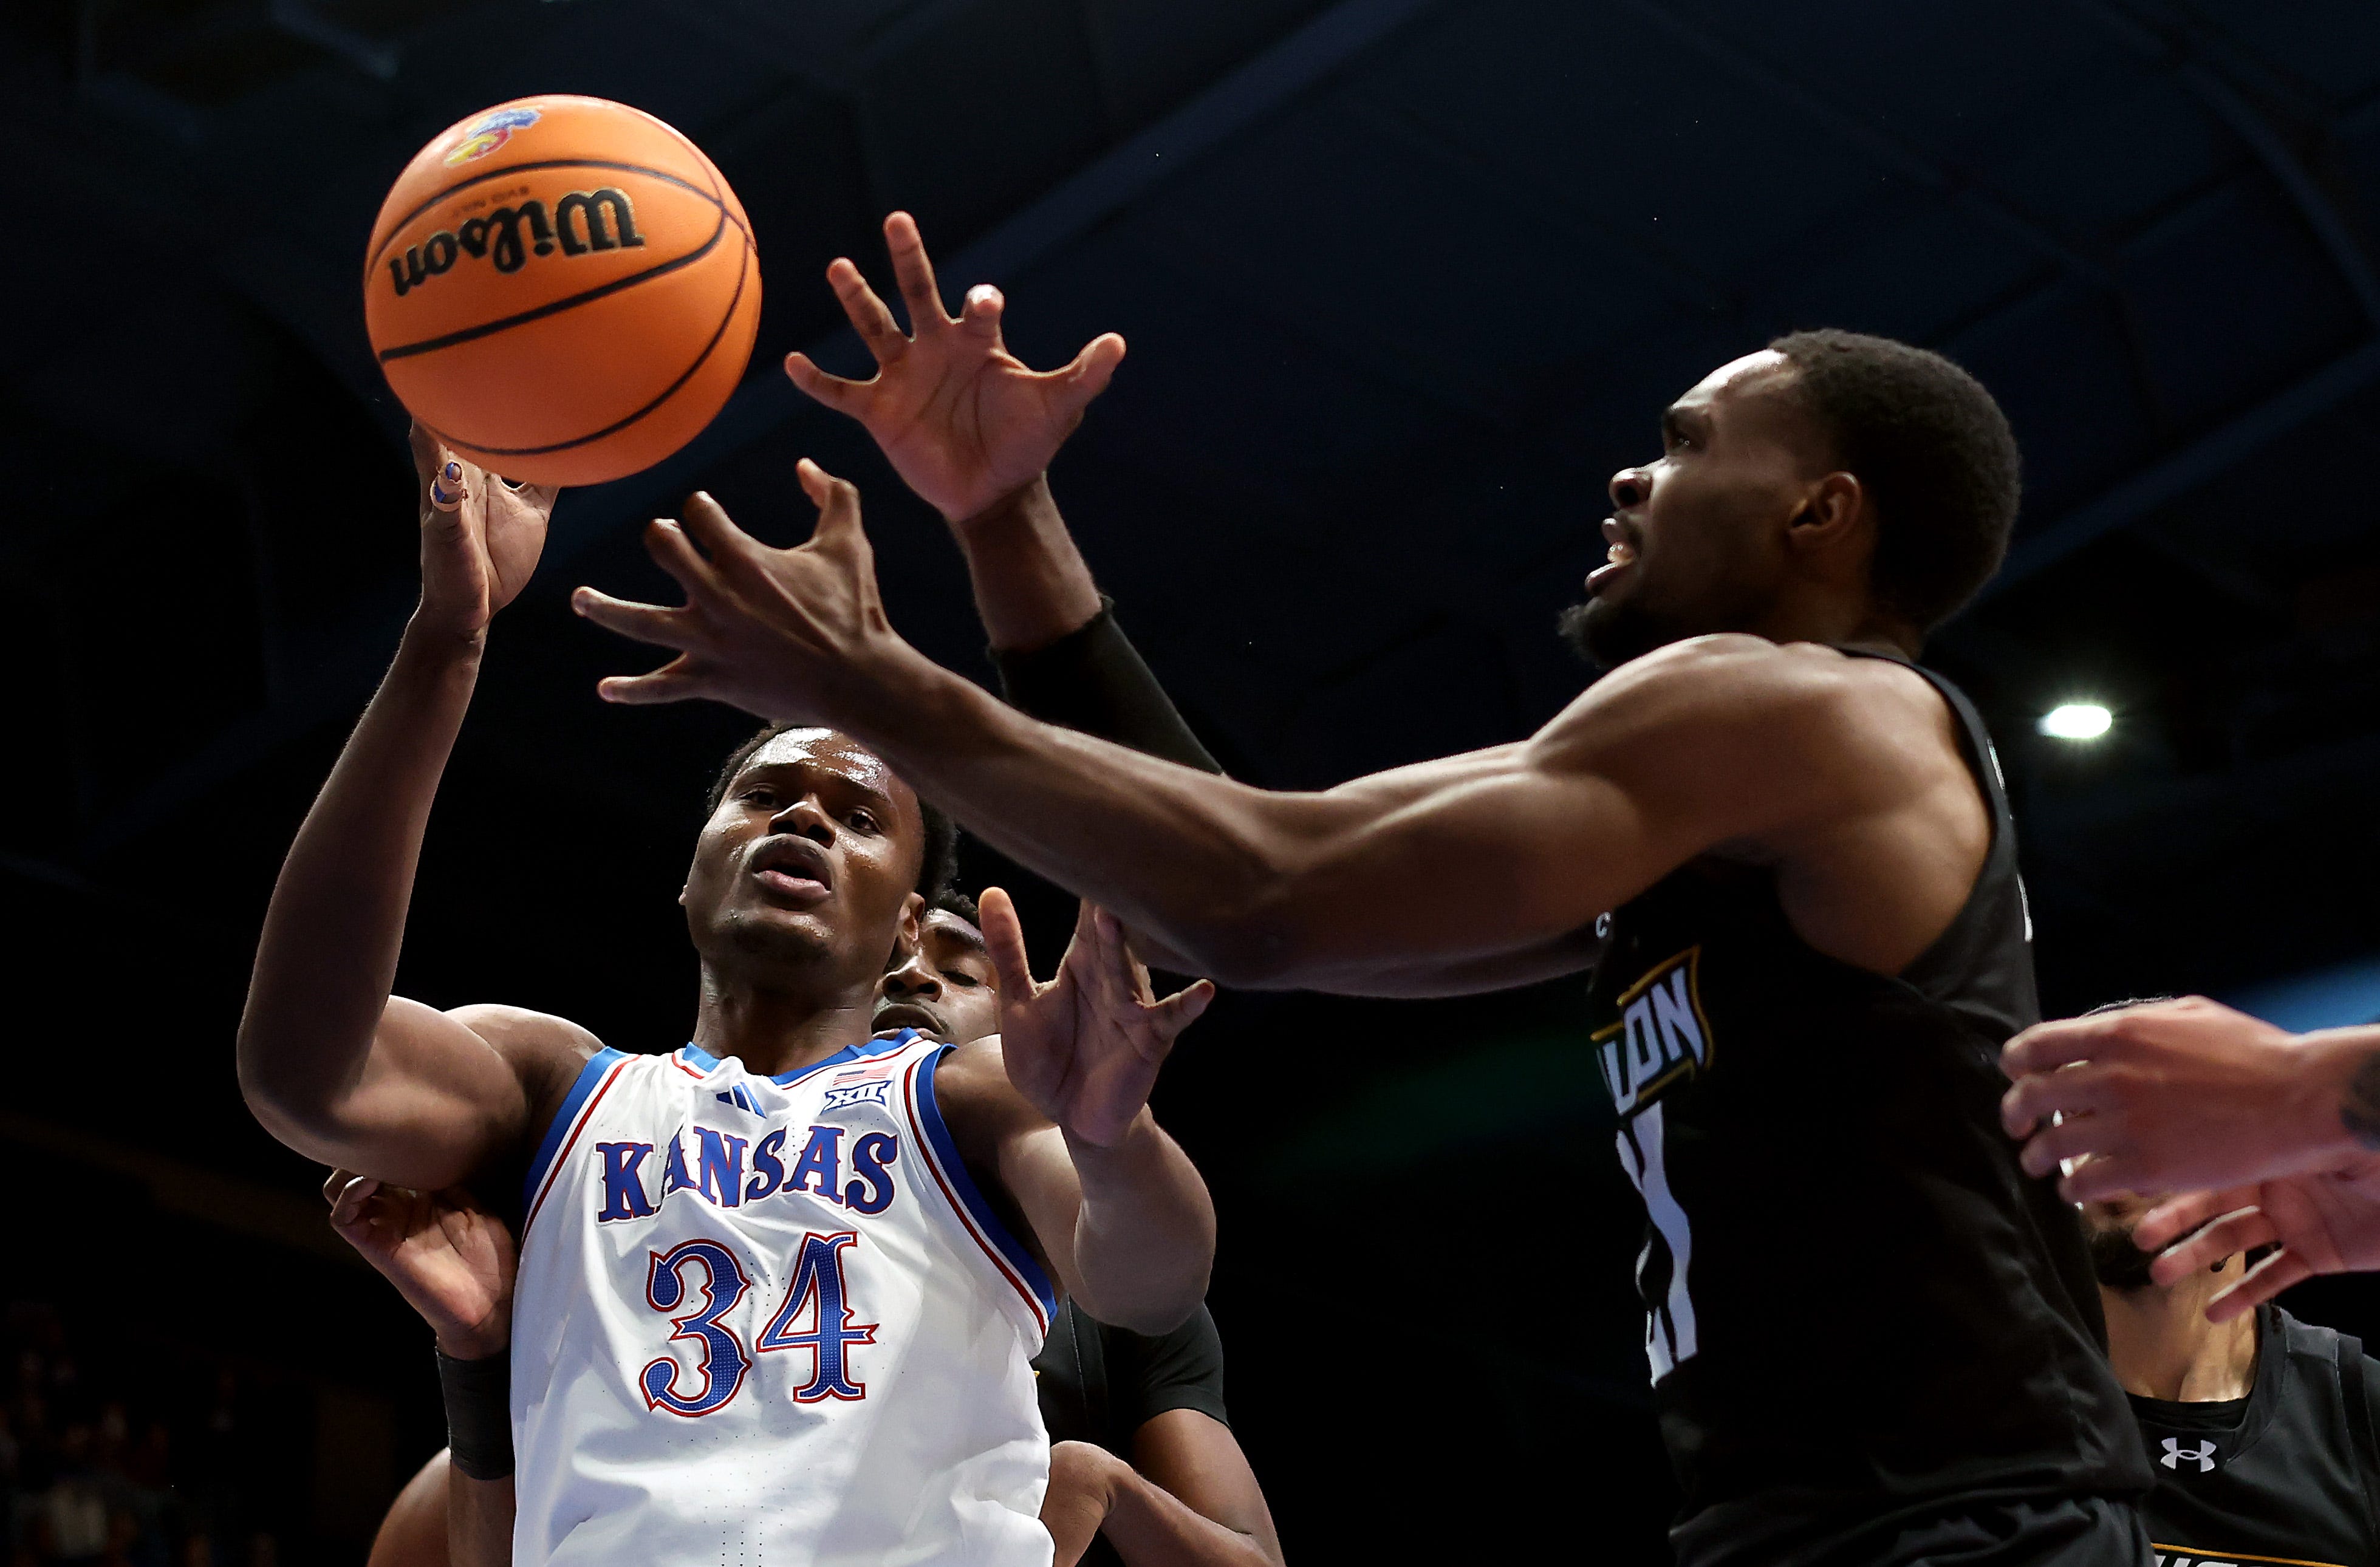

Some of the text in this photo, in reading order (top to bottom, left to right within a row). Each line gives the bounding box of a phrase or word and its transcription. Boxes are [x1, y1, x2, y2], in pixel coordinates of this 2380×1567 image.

[389, 187, 645, 296] Wilson
[819, 1081, 894, 1116] XII
[596, 1125, 898, 1223] KANSAS
[639, 1232, 879, 1417] 34
